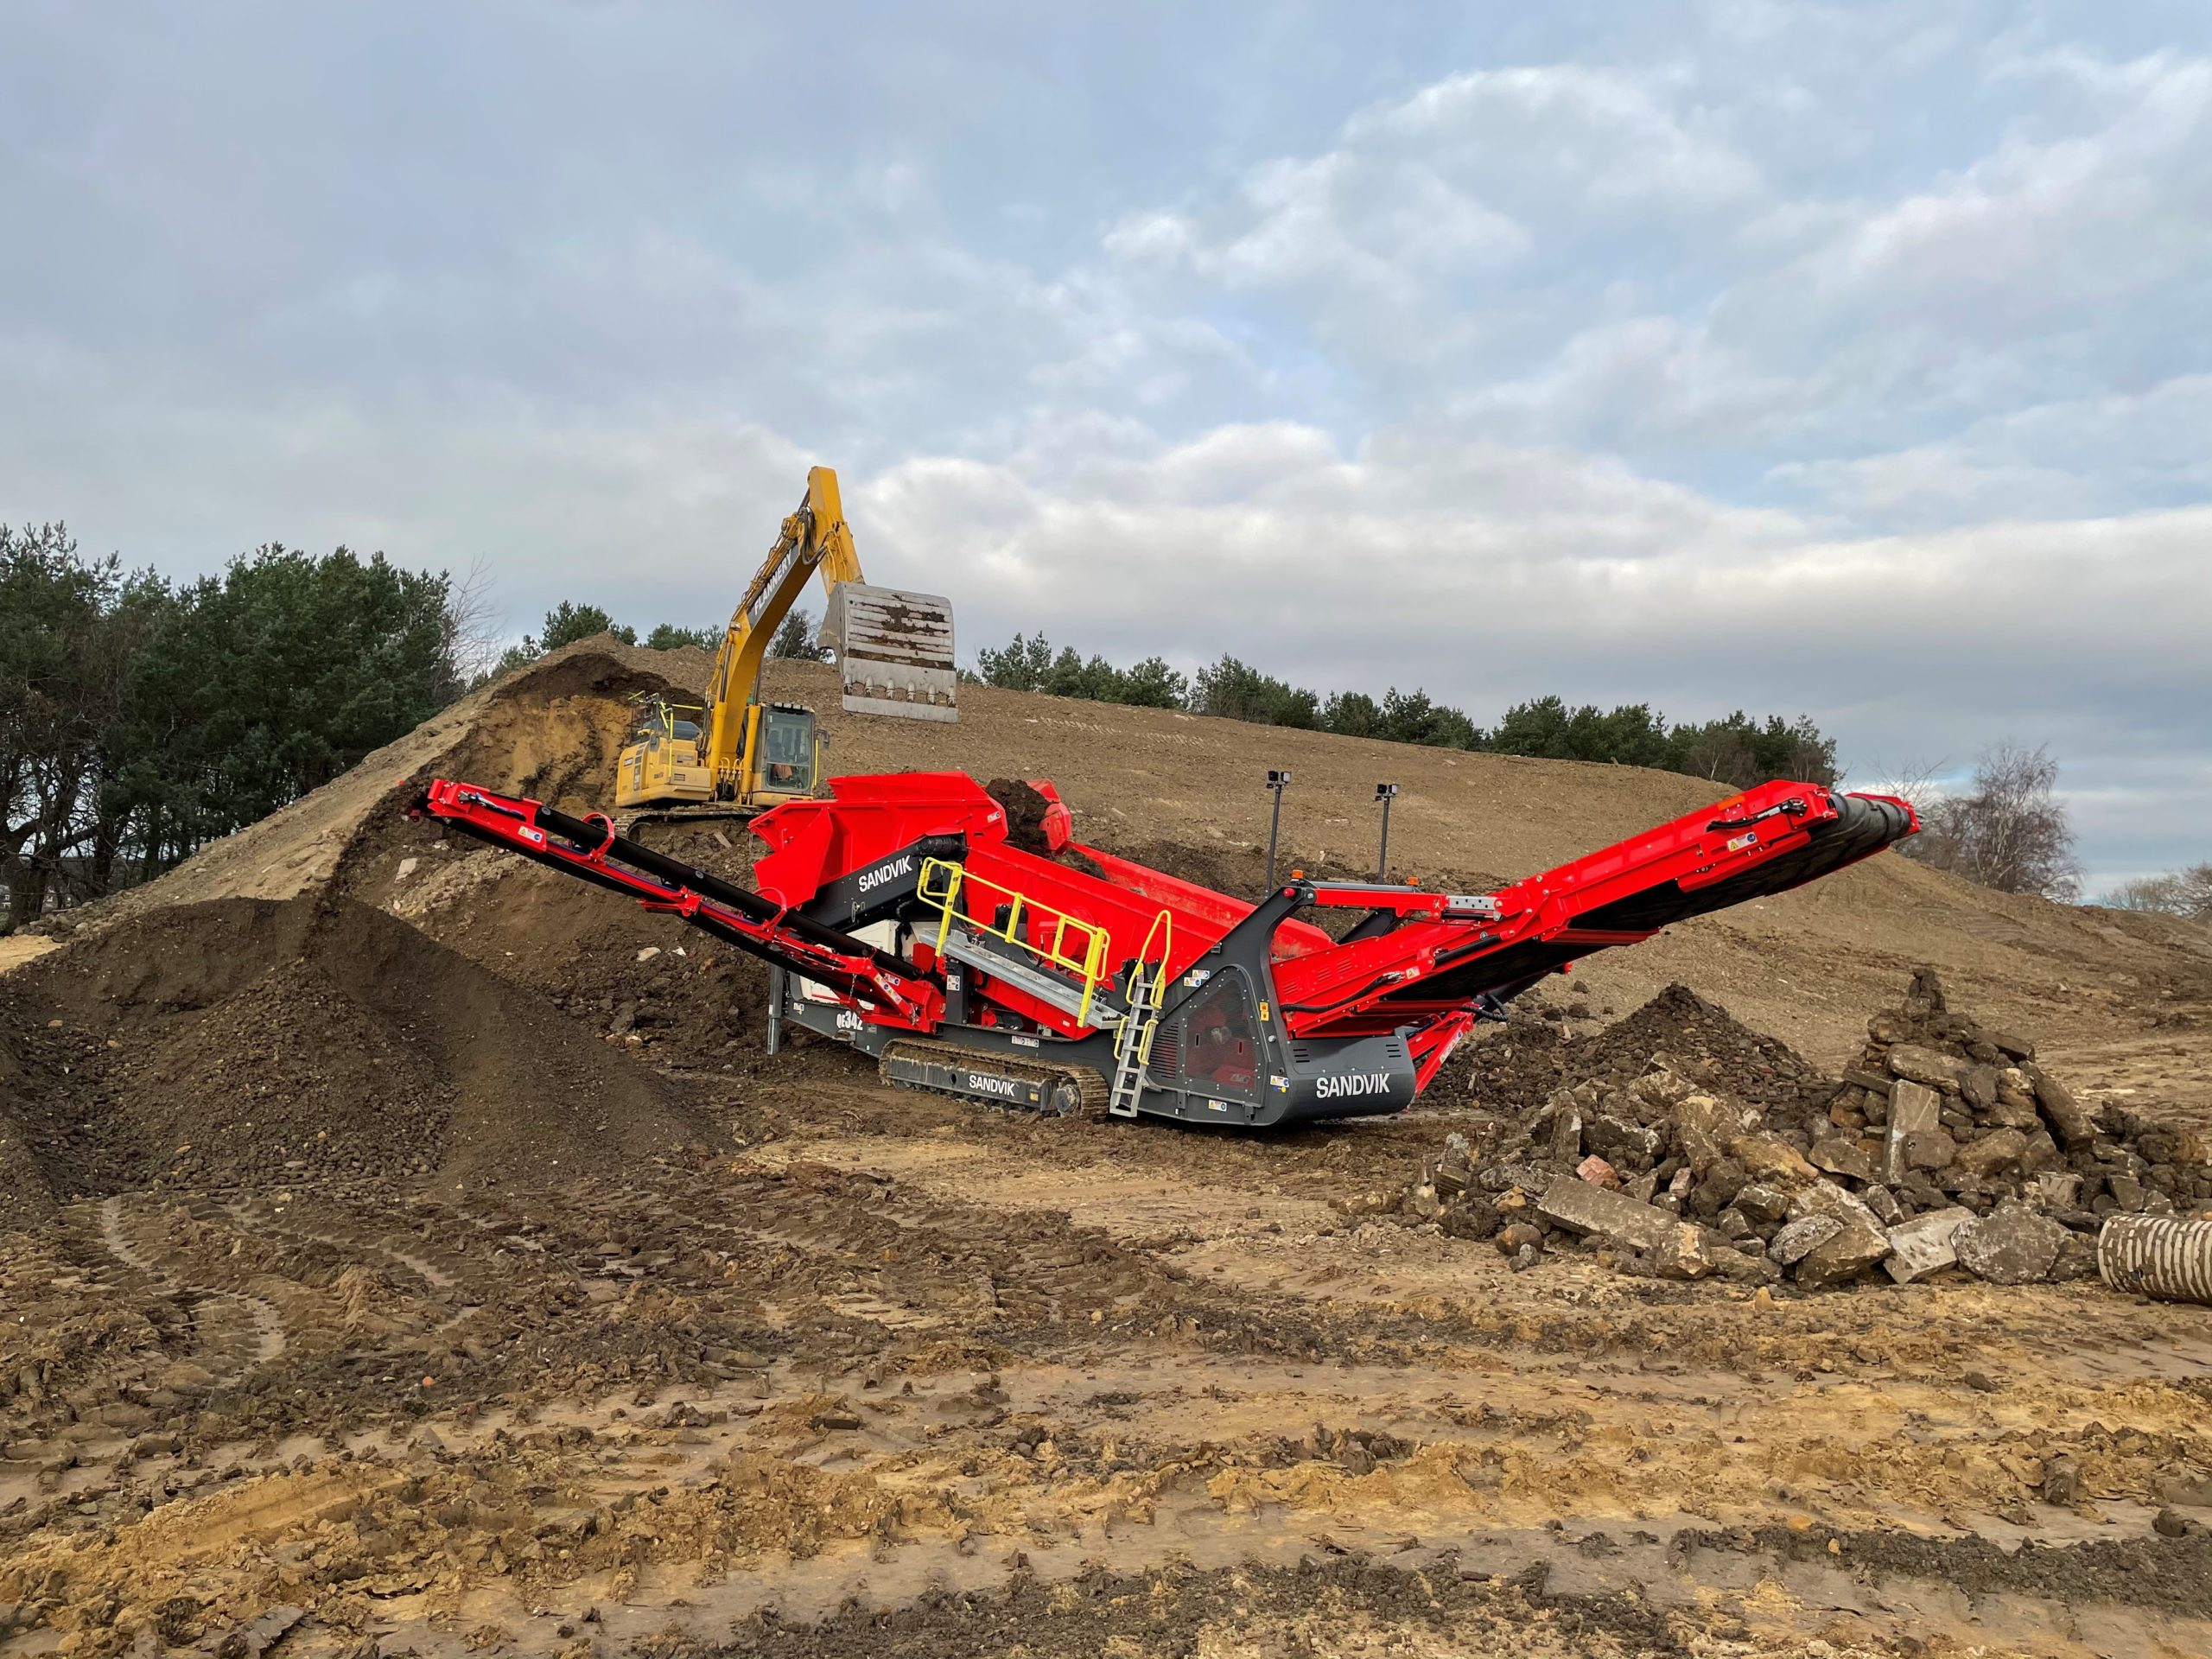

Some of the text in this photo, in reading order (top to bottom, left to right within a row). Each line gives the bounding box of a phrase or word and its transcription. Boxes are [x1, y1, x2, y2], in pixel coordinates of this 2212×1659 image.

[754, 549, 792, 615] FLANNERY
[858, 855, 912, 893] SANDVIK
[969, 1074, 1015, 1096] SANDVIK
[1316, 1072, 1390, 1099] SANDVIK
